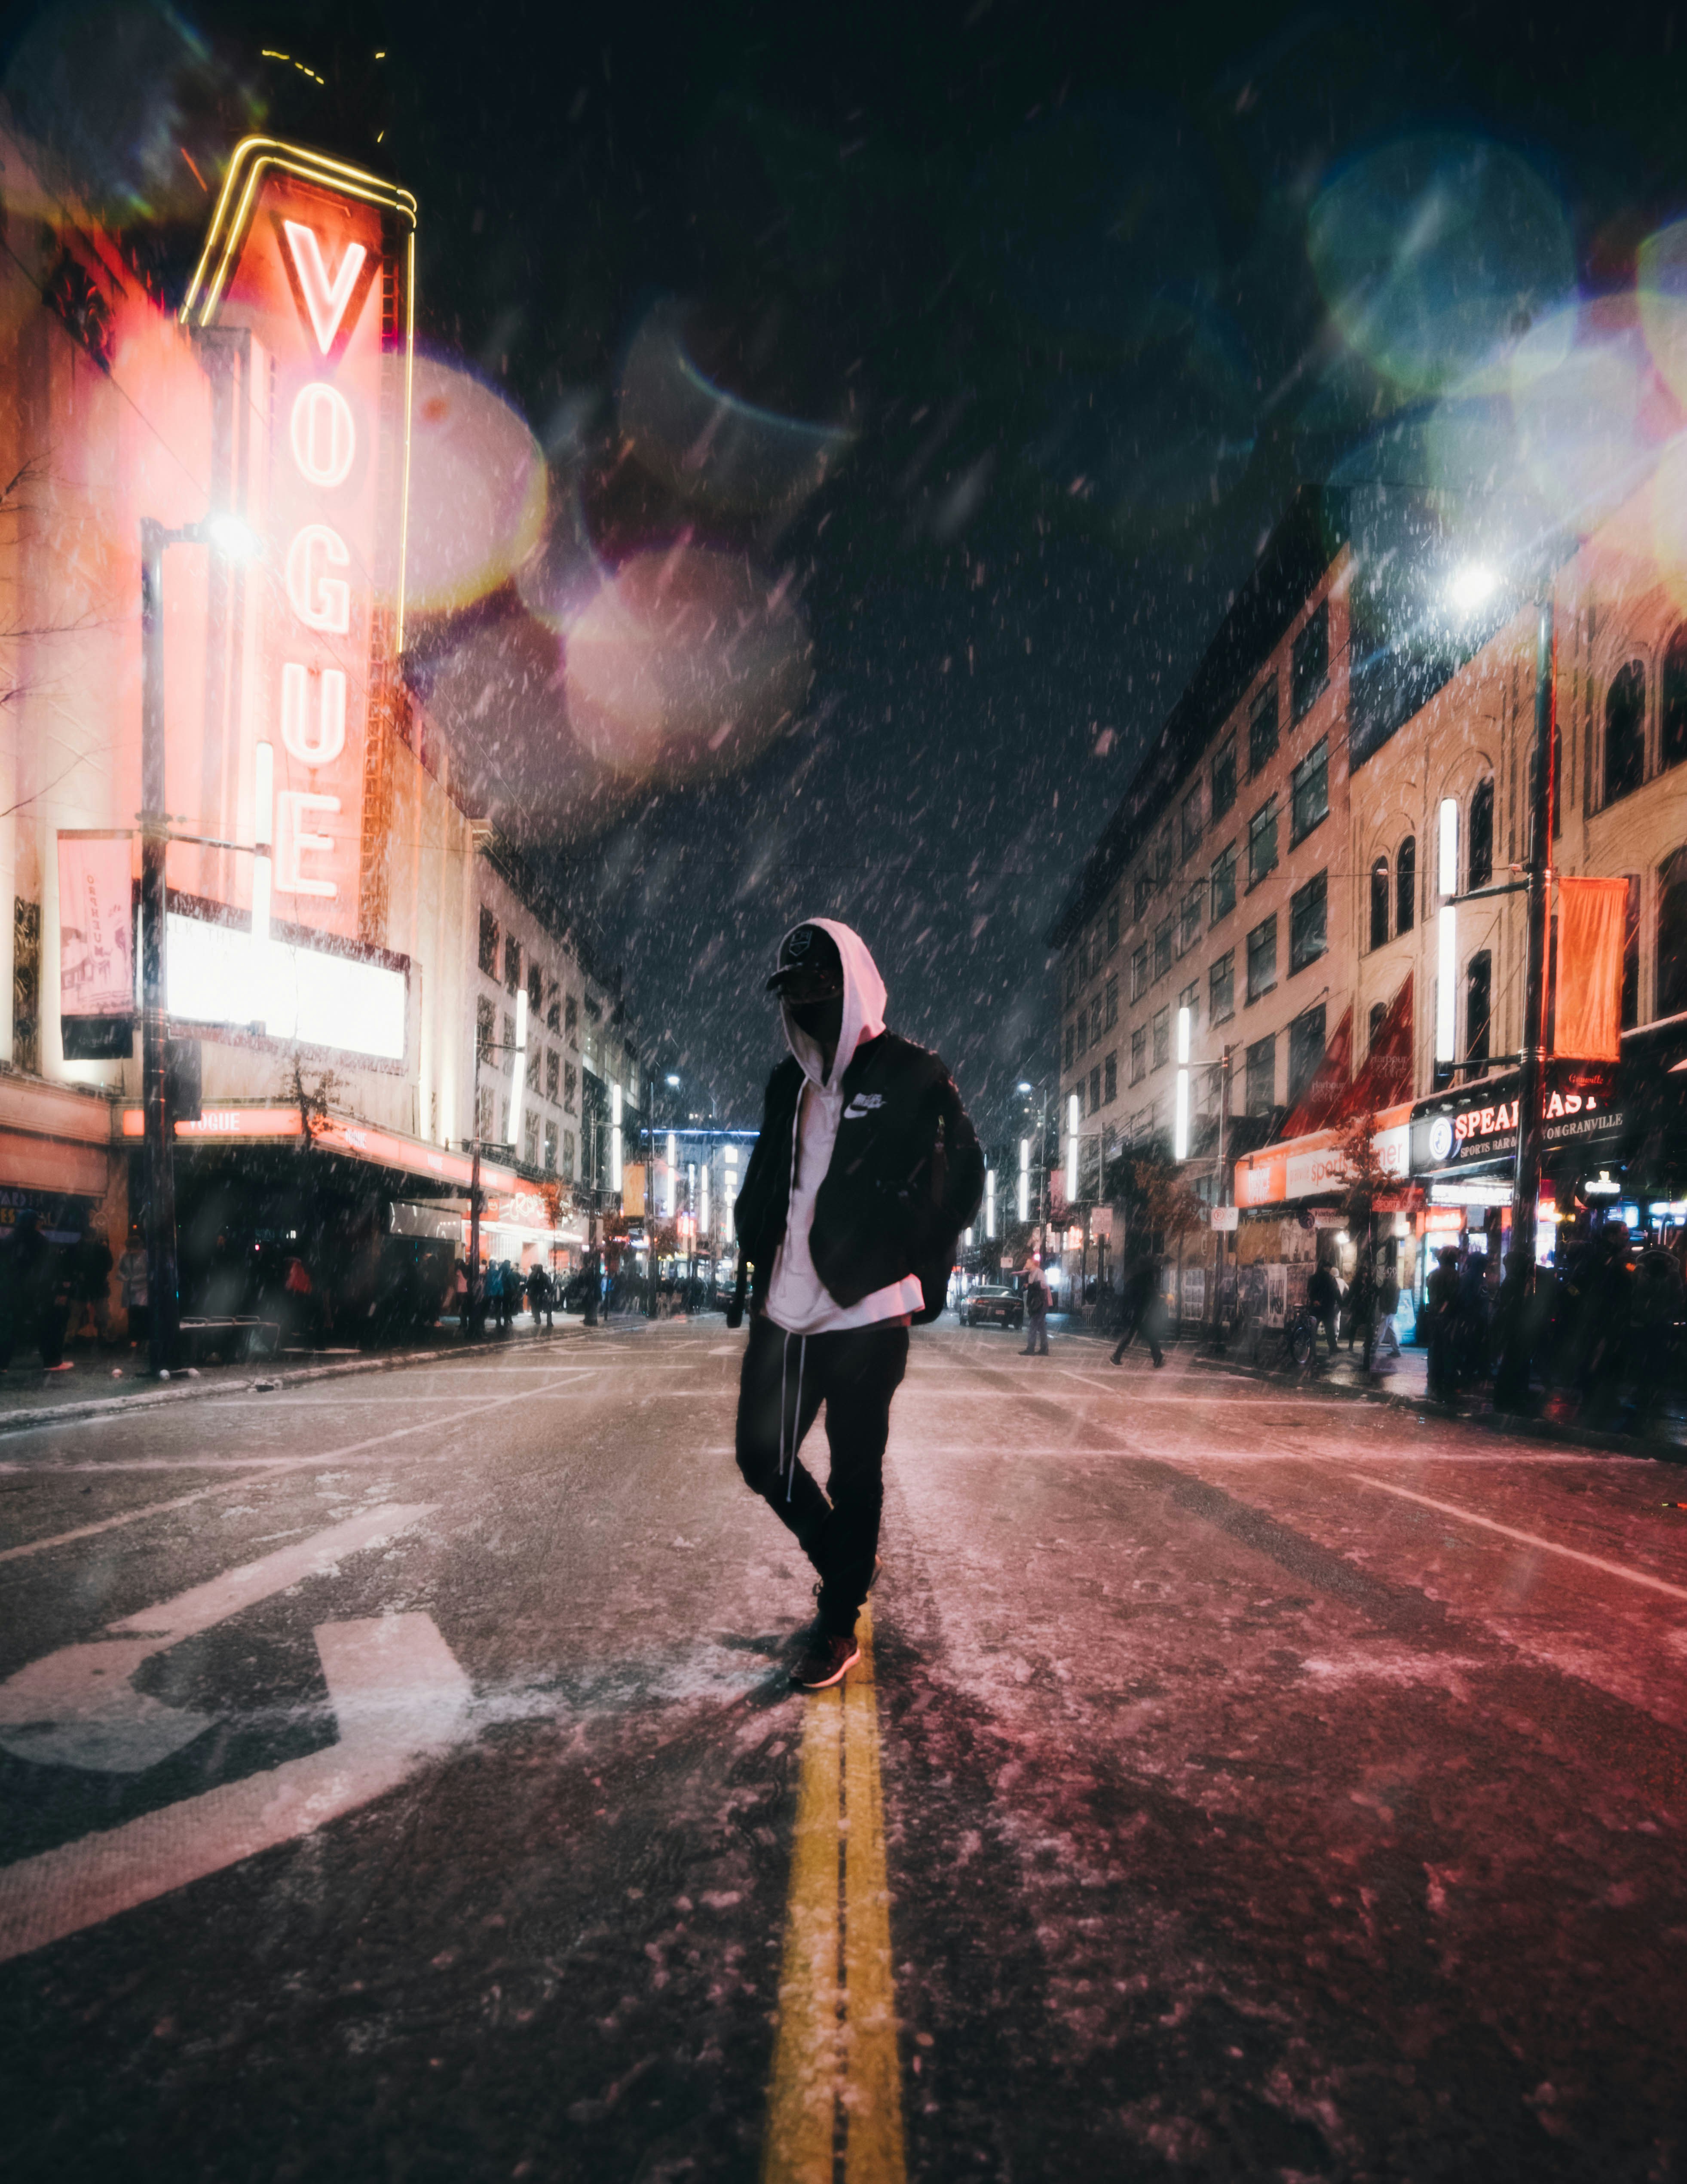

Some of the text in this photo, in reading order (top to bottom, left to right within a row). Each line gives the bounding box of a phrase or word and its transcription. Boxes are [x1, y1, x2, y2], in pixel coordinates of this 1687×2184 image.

[274, 218, 368, 899] VOGUE
[1455, 1090, 1597, 1140] SPEAAS
[1460, 1142, 1491, 1158] SPORTS
[1547, 1126, 1561, 1139] ON
[1561, 1113, 1623, 1136] GRANVILLE
